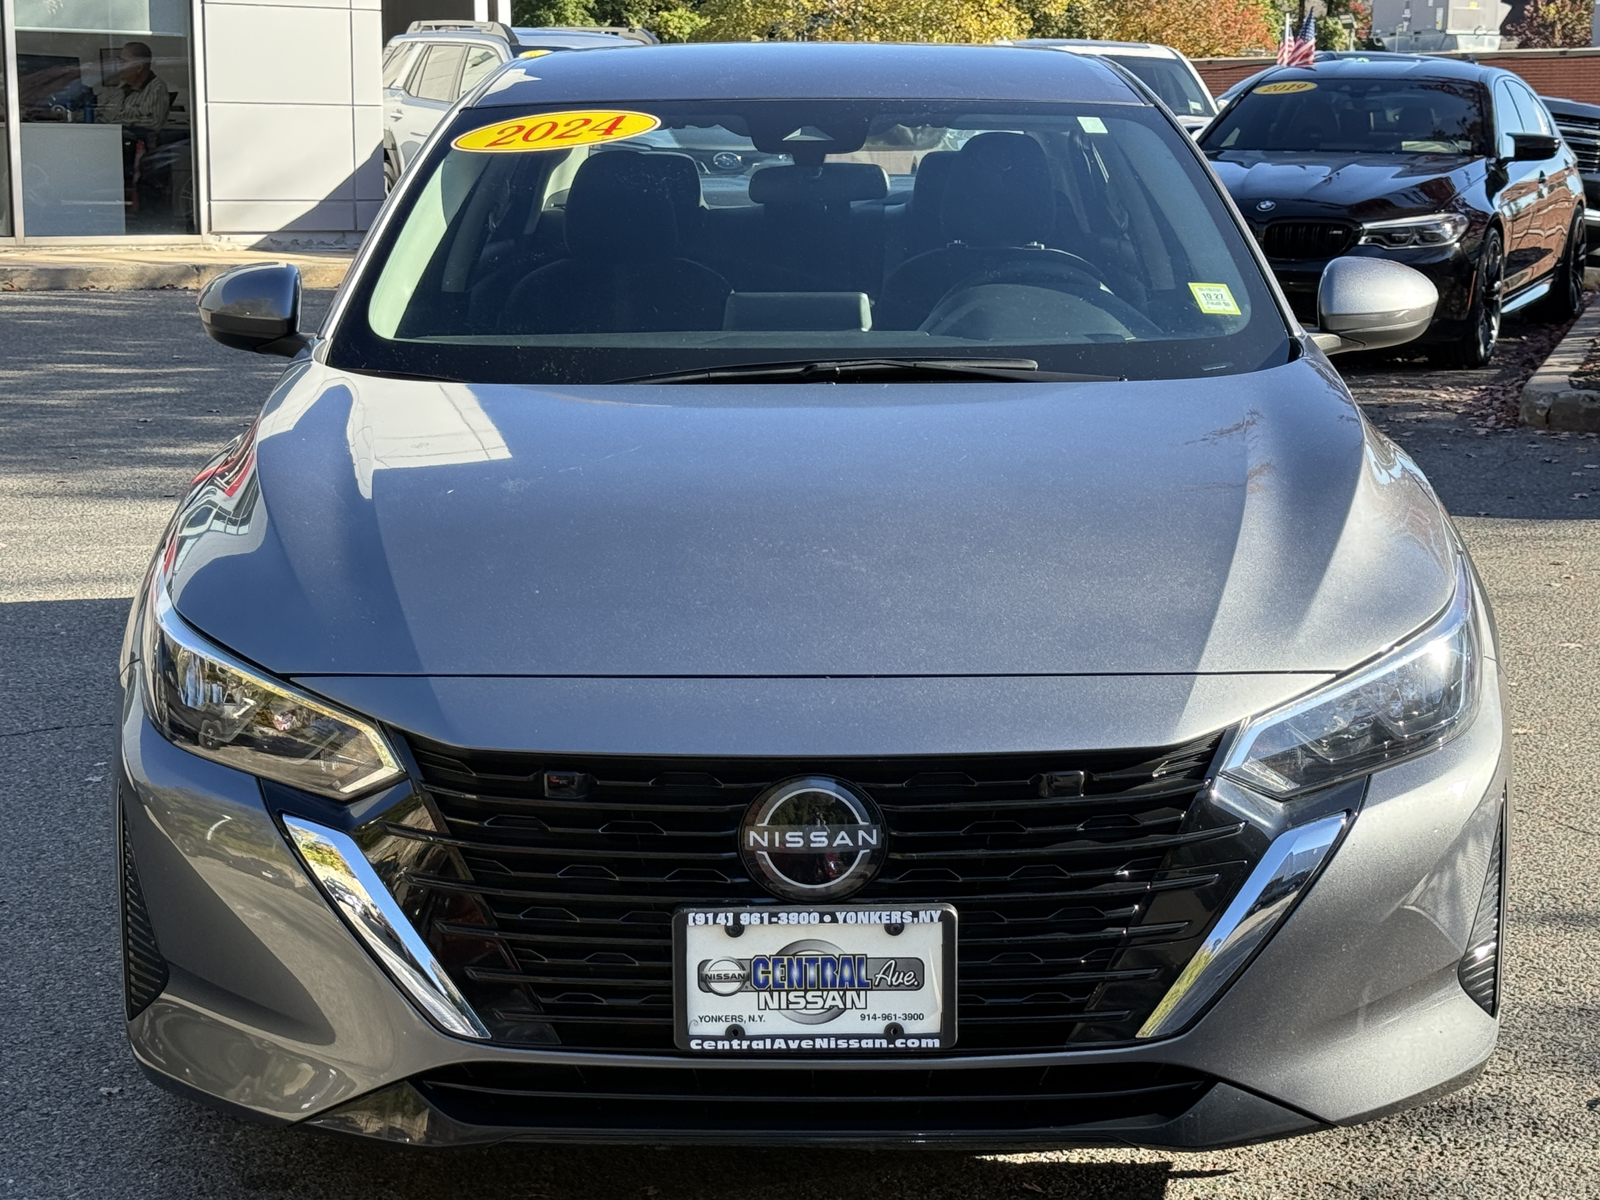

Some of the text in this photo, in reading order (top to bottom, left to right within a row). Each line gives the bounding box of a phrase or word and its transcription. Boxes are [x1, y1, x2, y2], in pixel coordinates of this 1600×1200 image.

[1262, 83, 1308, 93] 2019
[484, 115, 627, 148] 2024
[749, 829, 878, 848] NISSAN
[740, 911, 820, 926] 961-3900
[704, 973, 746, 981] NISSAN
[750, 954, 920, 991] CENTRAL Ave.
[758, 990, 868, 1011] NISSAN
[698, 1014, 766, 1024] YONKERS, N.Y.
[859, 1013, 925, 1022] 914-961-3900
[689, 1037, 941, 1050] CentralAveNissan.com
